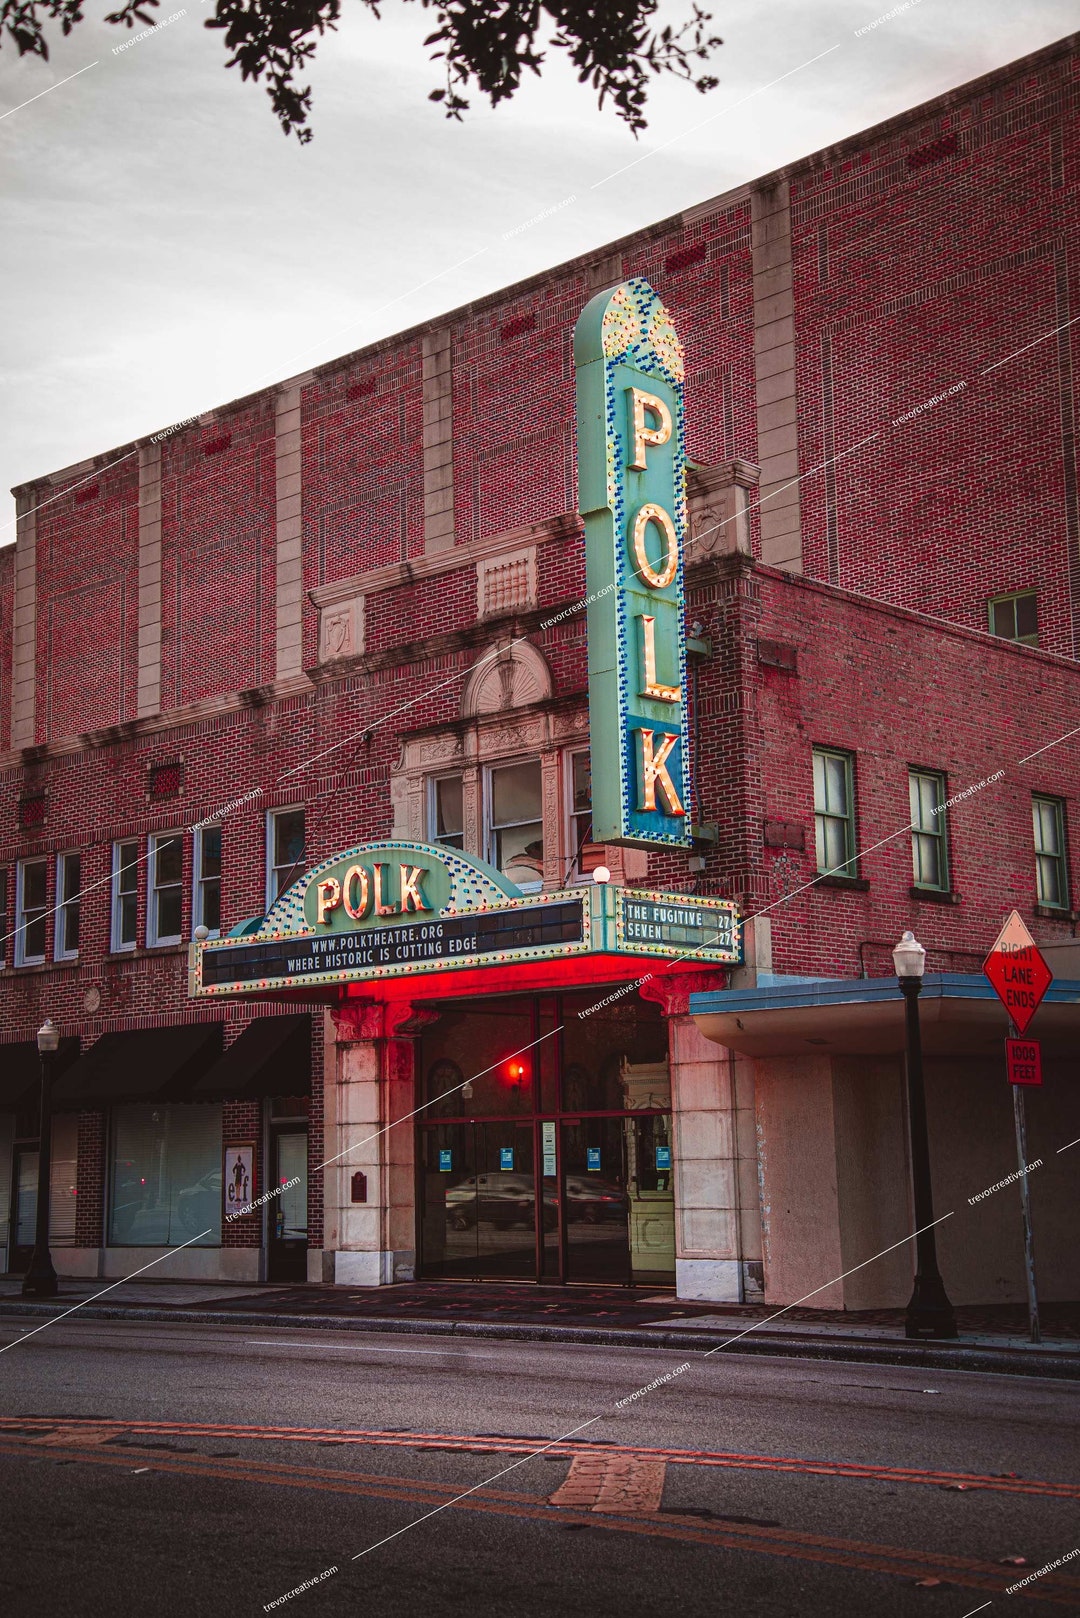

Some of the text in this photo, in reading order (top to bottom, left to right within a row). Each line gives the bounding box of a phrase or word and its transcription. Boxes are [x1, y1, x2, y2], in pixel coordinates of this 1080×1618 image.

[627, 386, 684, 818] POLK
[316, 862, 432, 925] POLK
[627, 904, 730, 929] THE FUGITIVE 27
[312, 924, 444, 954] WWW.POLKTHEATRE.ORG
[628, 922, 730, 945] SEVEN 27
[287, 936, 477, 973] WHERE HISTORIC IS CUTTING EDGE
[1000, 941, 1034, 962] RIGHT
[1003, 967, 1034, 985] LANE
[1006, 989, 1035, 1009] ENDS
[1011, 1045, 1036, 1062] 1000
[1012, 1064, 1036, 1080] FEET
